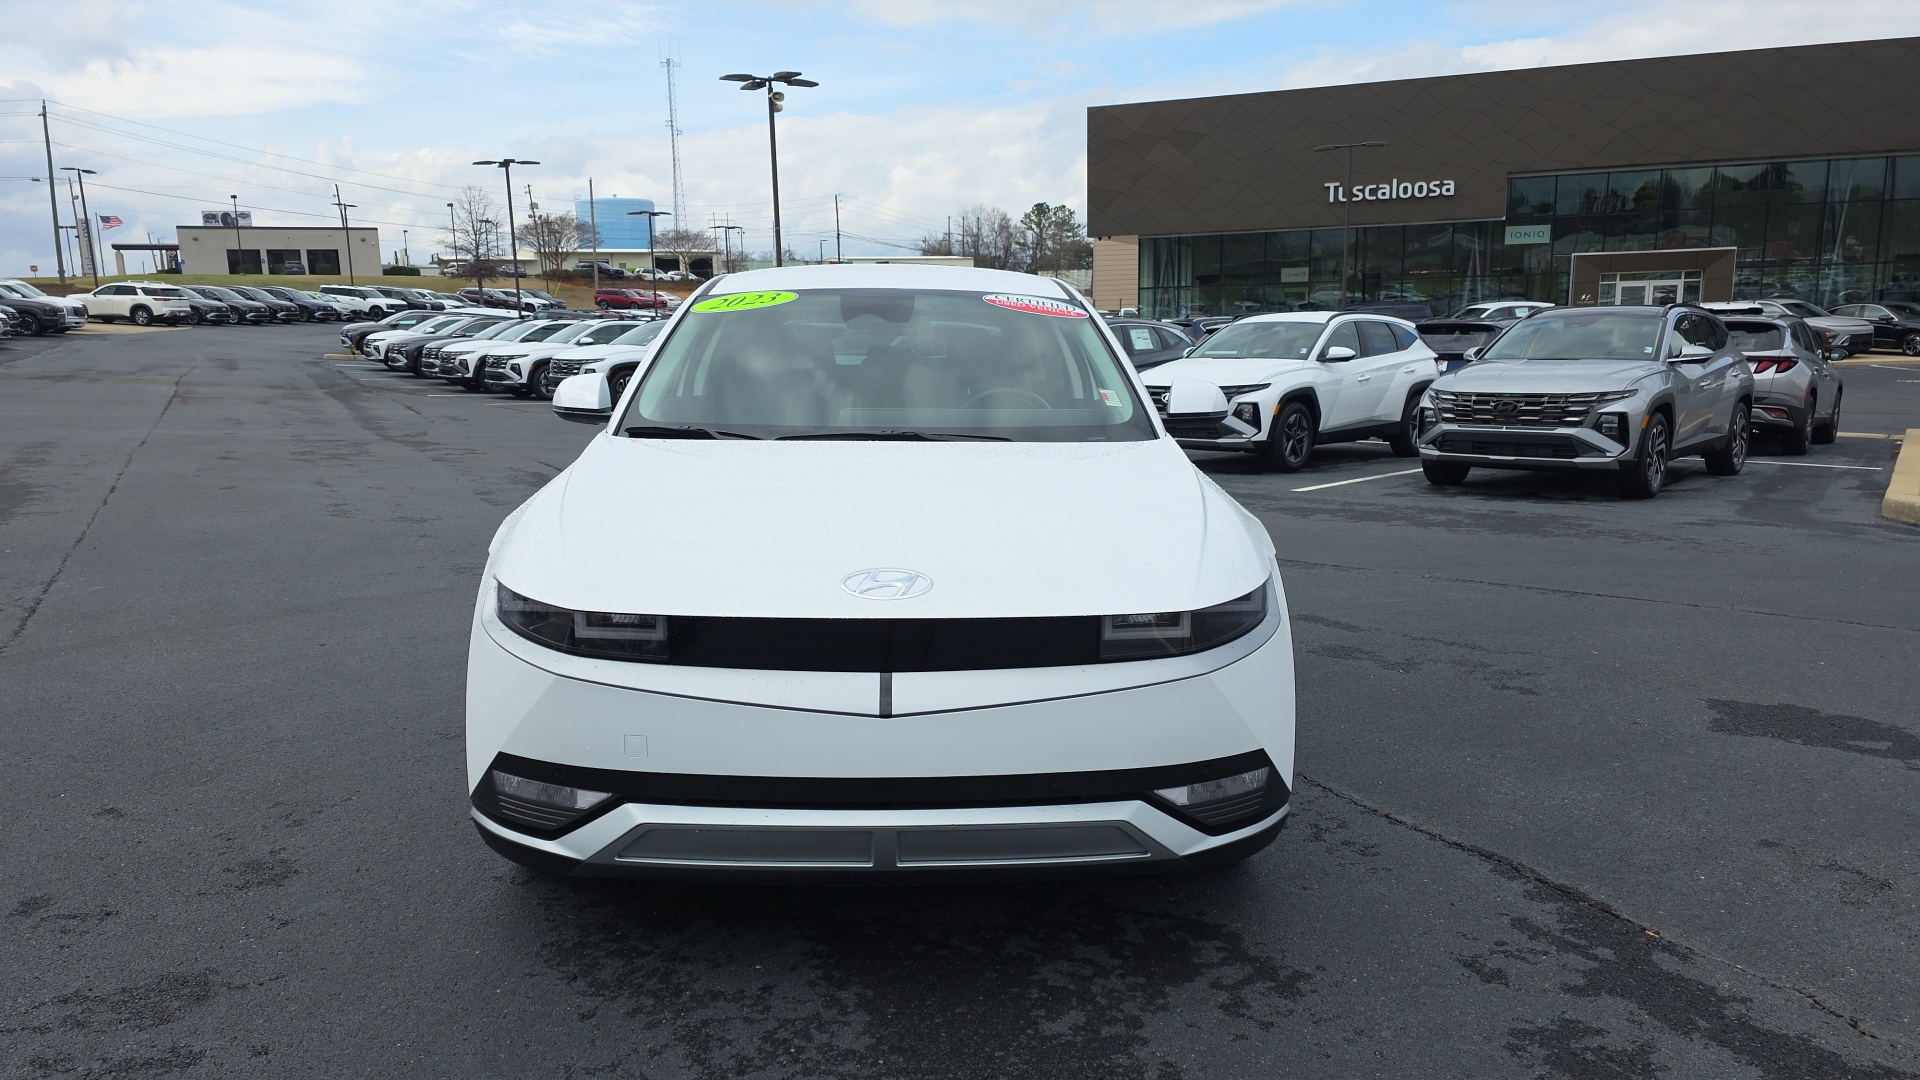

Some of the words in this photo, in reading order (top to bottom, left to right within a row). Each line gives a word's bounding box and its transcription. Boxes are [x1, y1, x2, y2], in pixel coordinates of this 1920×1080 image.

[1324, 178, 1455, 203] Tuscaloosa
[1510, 230, 1545, 239] IONIQ
[706, 293, 781, 310] 2023
[994, 294, 1076, 312] CERTIFIED
[995, 300, 1026, 308] USED
[1029, 304, 1078, 317] VEHICLE
